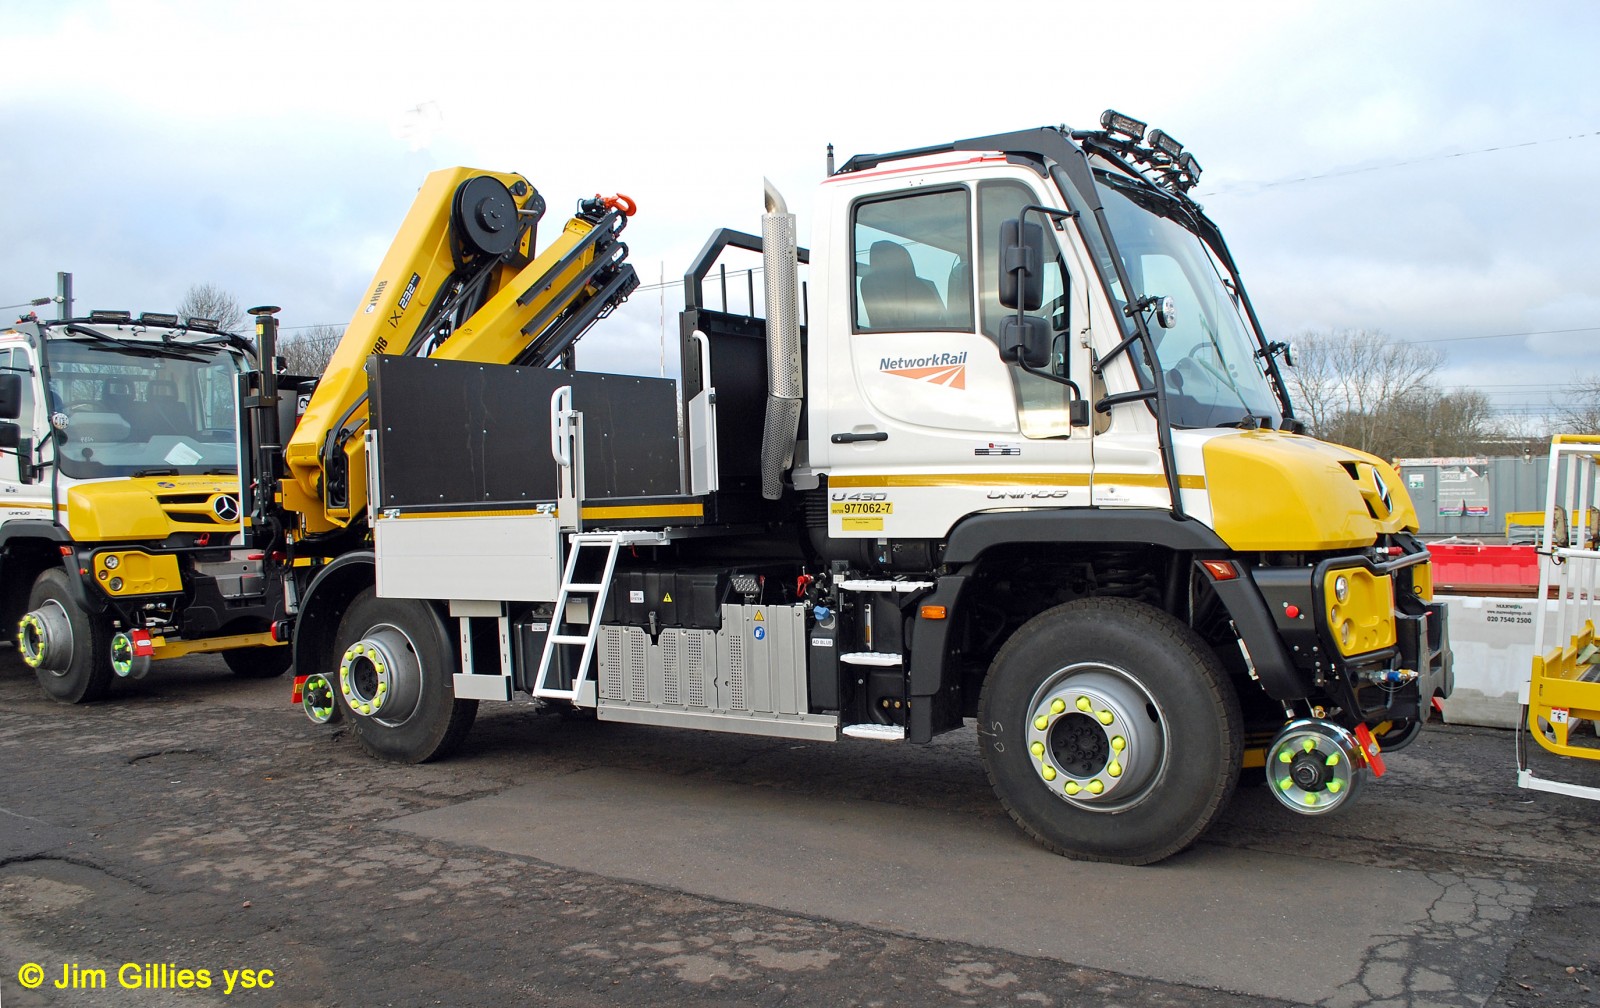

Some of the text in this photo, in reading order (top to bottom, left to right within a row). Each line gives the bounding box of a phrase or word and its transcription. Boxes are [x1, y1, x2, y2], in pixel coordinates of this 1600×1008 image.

[831, 492, 888, 502] U 430
[844, 503, 891, 514] 977062-7
